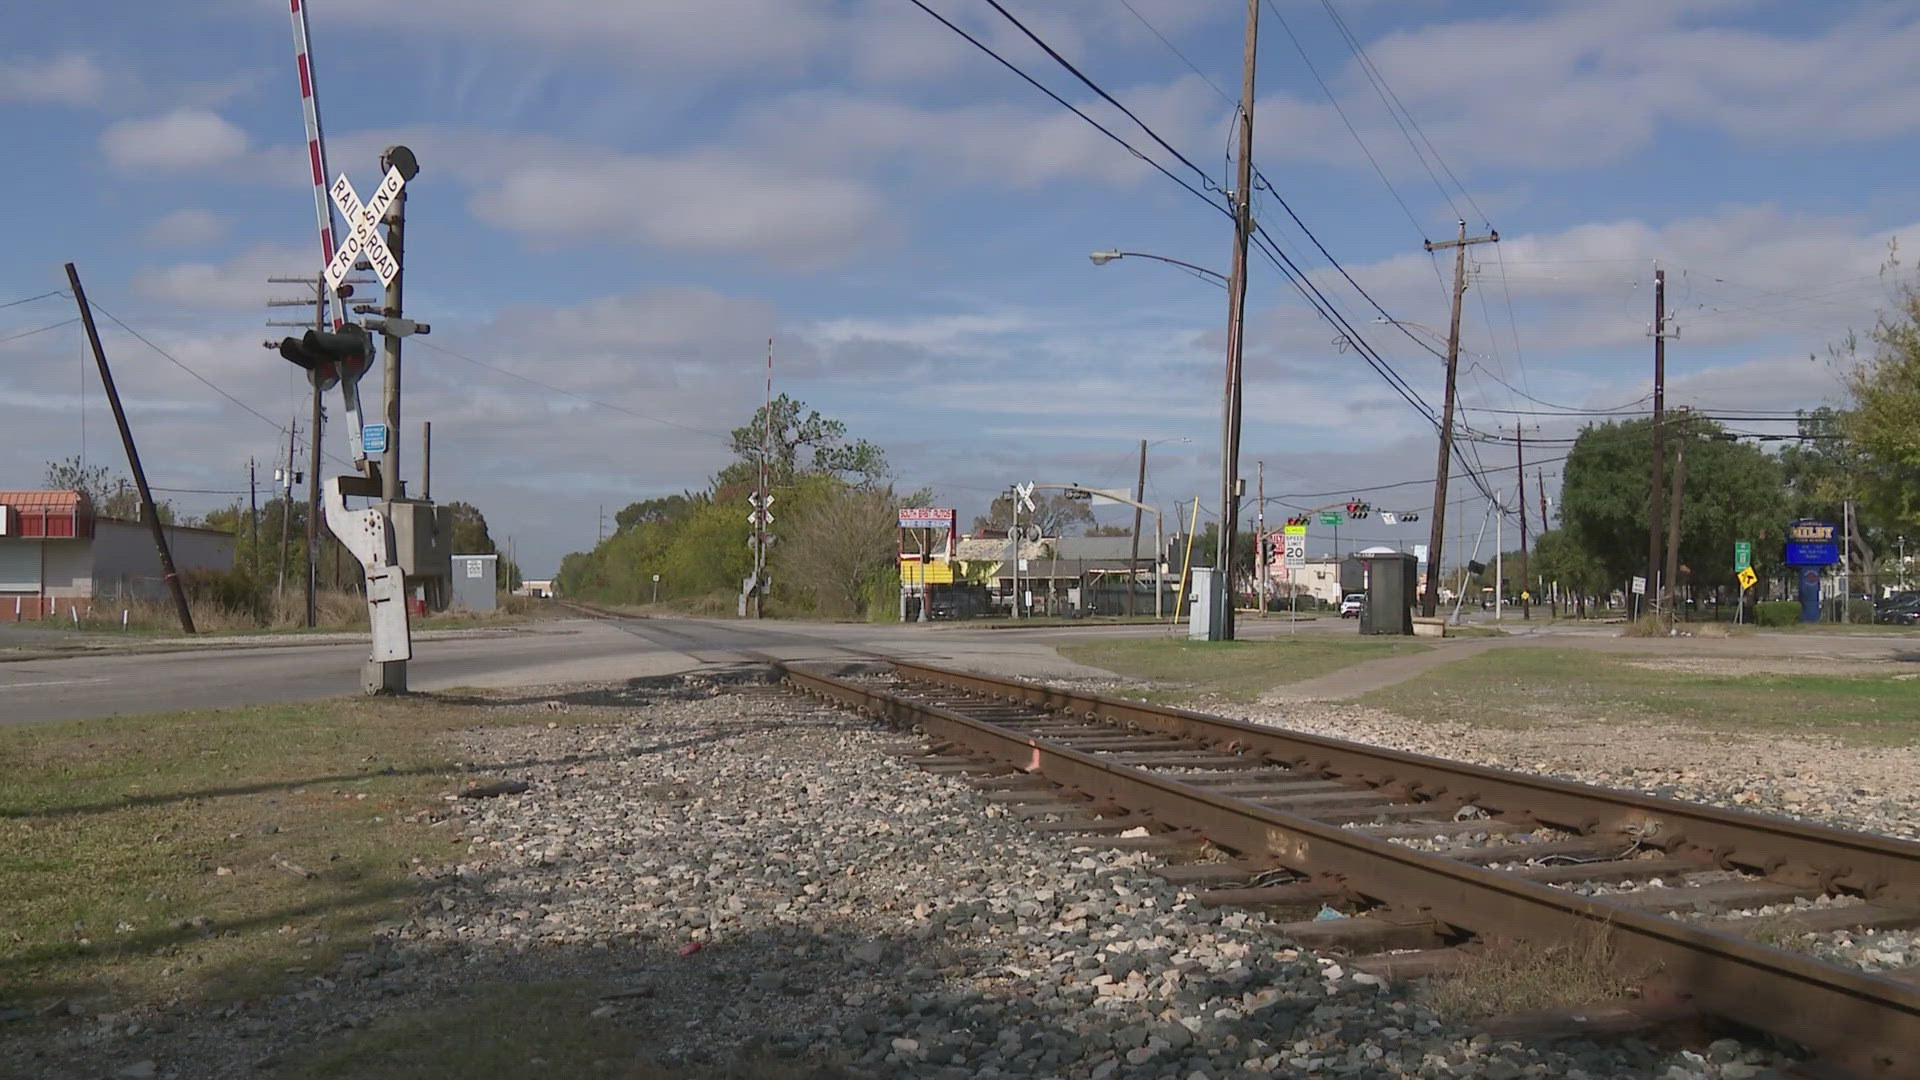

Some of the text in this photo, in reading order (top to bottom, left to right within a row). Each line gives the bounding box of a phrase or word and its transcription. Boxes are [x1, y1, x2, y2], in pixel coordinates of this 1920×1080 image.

[331, 176, 398, 279] CROSSING
[333, 180, 394, 280] RAIL ROAD
[900, 509, 951, 518] SOUTH EAST AUTOS
[1789, 526, 1834, 539] MILBY
[1286, 547, 1303, 558] 20
